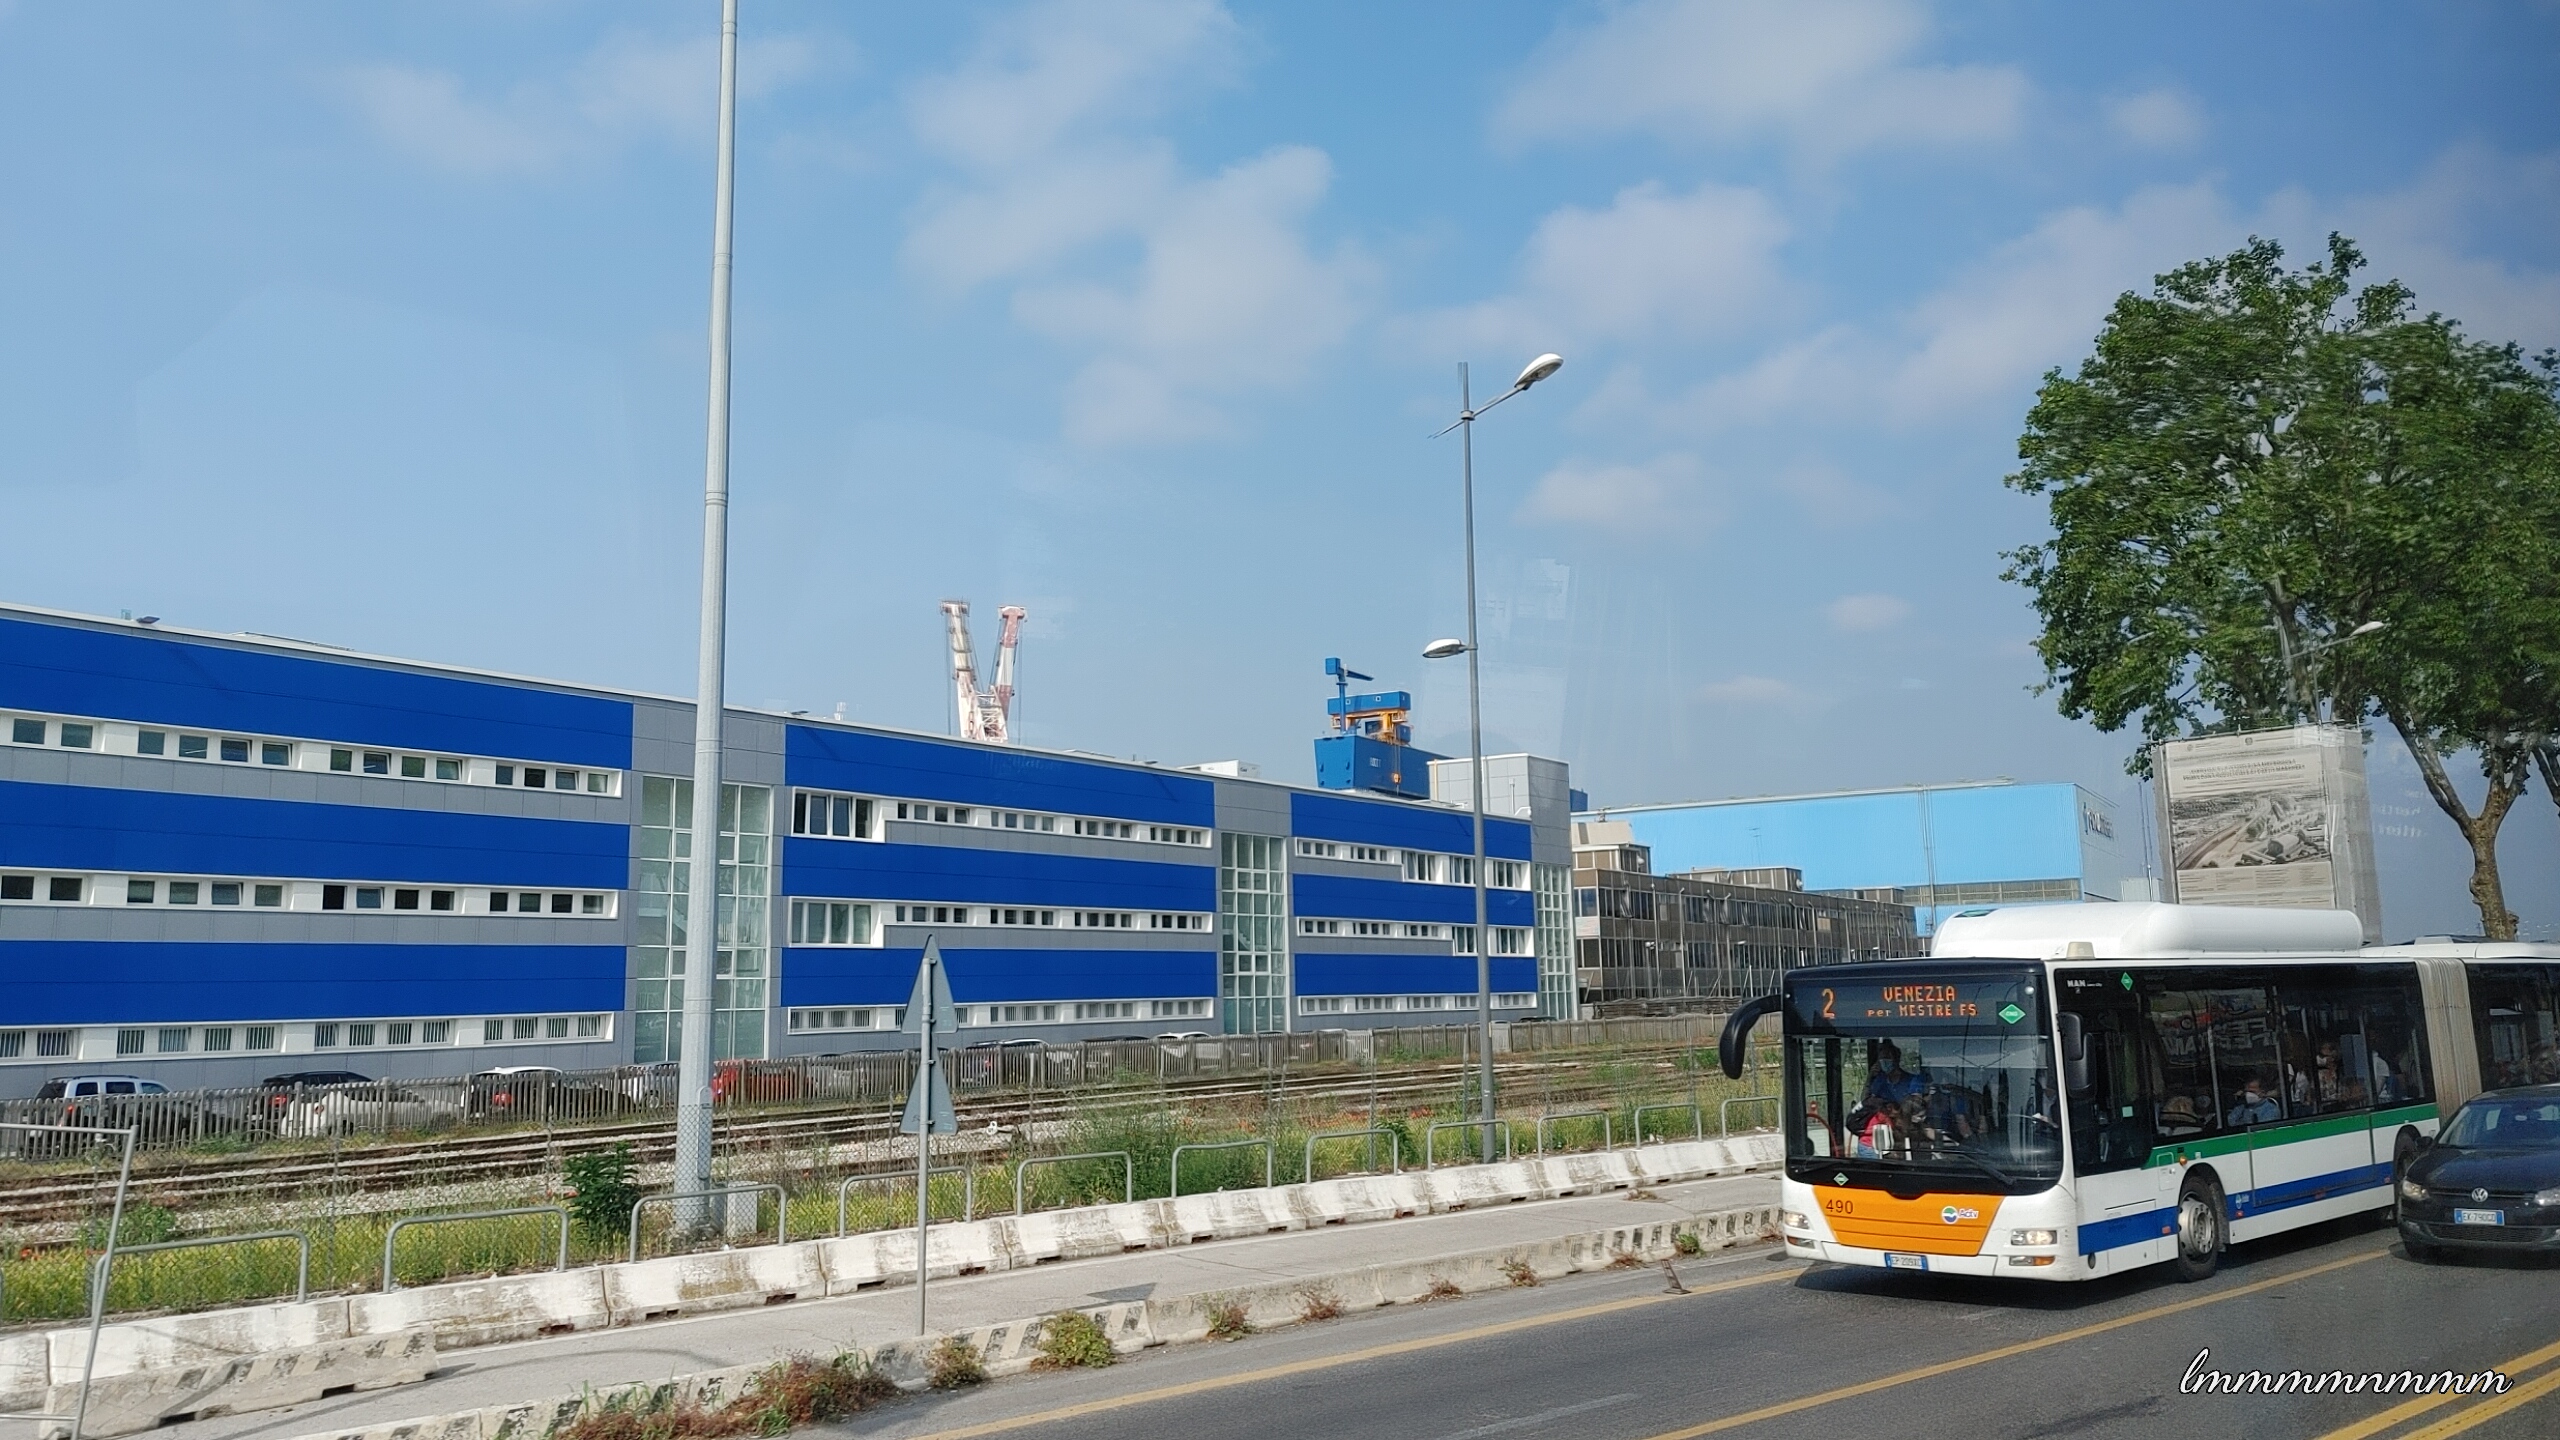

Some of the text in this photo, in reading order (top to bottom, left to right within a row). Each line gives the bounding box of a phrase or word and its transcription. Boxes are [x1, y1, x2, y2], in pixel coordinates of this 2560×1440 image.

[2067, 980, 2086, 988] MAN
[1883, 985, 1956, 1002] VENEZIA
[1821, 988, 1835, 1019] 2
[1867, 1003, 1978, 1018] per MESTRE FS
[1825, 1198, 1854, 1215] 490
